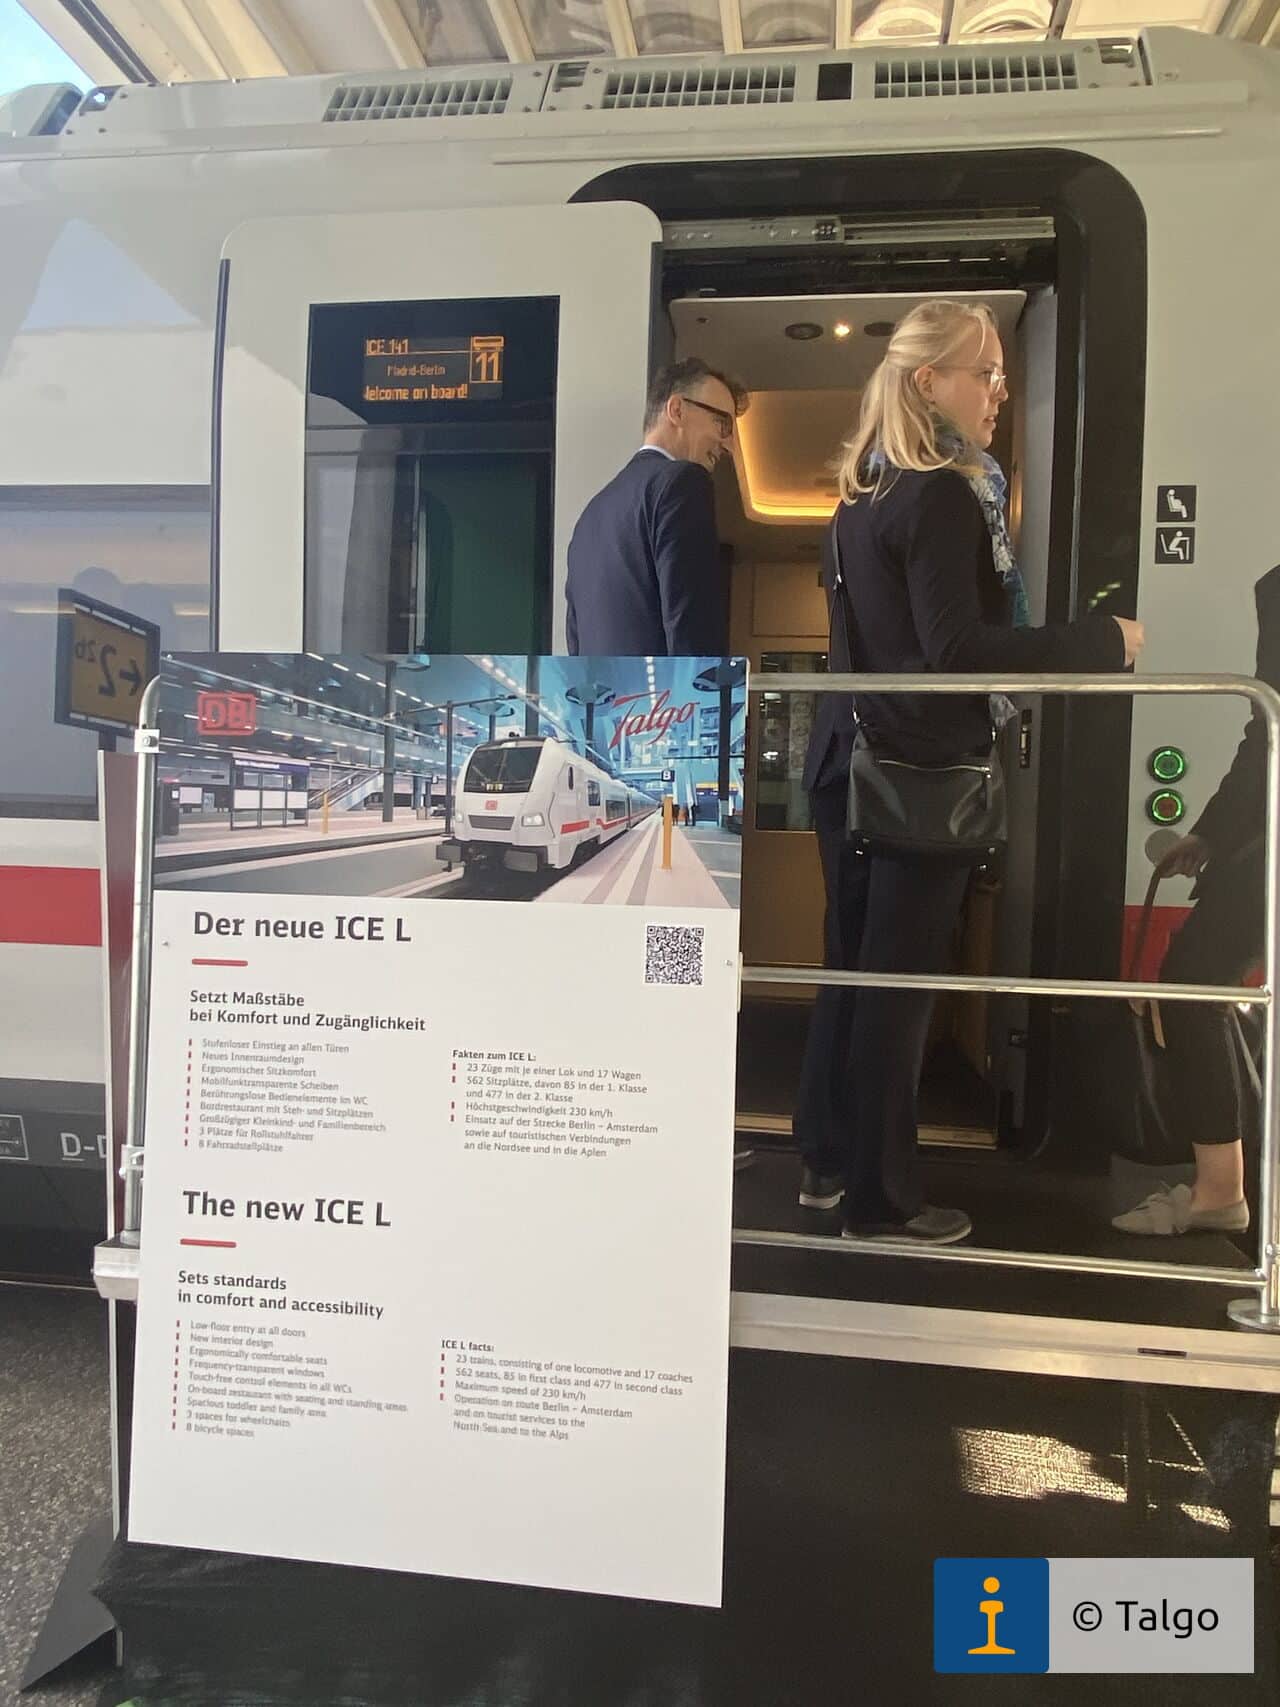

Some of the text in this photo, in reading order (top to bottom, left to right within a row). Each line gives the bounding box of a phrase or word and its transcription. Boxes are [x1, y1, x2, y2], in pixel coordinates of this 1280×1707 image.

[366, 338, 408, 354] ICE 141
[476, 351, 500, 381] 11
[413, 388, 428, 400] on
[431, 384, 468, 399] board!
[203, 697, 250, 731] DB
[608, 690, 700, 750] Talgo
[194, 911, 412, 942] Der neue ICE L
[190, 990, 304, 1007] Setzt Maßstäbe
[190, 1009, 426, 1032] bei Komfort und Zugänglichkeit
[453, 1050, 484, 1060] Fakten
[509, 1052, 525, 1060] ICE
[528, 1053, 536, 1062] L:
[467, 1063, 642, 1081] 23 Züge mit je einer Lok und 17 Wagen
[467, 1076, 484, 1086] 562
[535, 1080, 561, 1088] davon
[564, 1081, 576, 1090] 85
[578, 1082, 586, 1090] in
[590, 1082, 604, 1091] der
[619, 1084, 648, 1094] Klasse
[466, 1090, 483, 1098] und
[486, 1090, 502, 1099] 477
[506, 1091, 514, 1100] in
[517, 1092, 532, 1100] der
[546, 1093, 574, 1102] Klasse
[466, 1102, 613, 1119] Höchstgeschwindigkeit 230 km/h
[466, 1114, 658, 1134] Einsatz auf der Strecke Berlin Amsterdam
[465, 1129, 632, 1146] sowie auf touristischen Verbindungen
[464, 1142, 475, 1150] an
[478, 1142, 492, 1150] die
[494, 1142, 531, 1153] Nordsee
[534, 1146, 550, 1154] und
[564, 1146, 578, 1155] die
[183, 1190, 392, 1226] The new ICE L
[179, 1270, 287, 1290] Sets standards
[178, 1289, 384, 1320] in comfort and accessibility
[282, 1328, 306, 1337] doors
[246, 1338, 274, 1348] design
[442, 1340, 494, 1352] ICE L facts:
[456, 1354, 468, 1364] 23
[499, 1360, 542, 1372] consisting
[544, 1361, 553, 1370] of
[556, 1364, 572, 1372] one
[574, 1364, 622, 1377] locomotive
[624, 1369, 641, 1378] and
[644, 1370, 655, 1380] 17
[658, 1372, 694, 1384] coaches
[456, 1368, 472, 1377] 562
[504, 1372, 515, 1381] 85
[518, 1372, 526, 1381] in
[529, 1373, 547, 1384] first
[550, 1376, 571, 1386] class
[574, 1378, 590, 1388] and
[594, 1380, 611, 1390] 477
[614, 1382, 622, 1390] in
[626, 1383, 658, 1394] second
[660, 1386, 683, 1396] class
[456, 1380, 586, 1401] Maximum speed of 230 km/h
[516, 1401, 540, 1410] route
[542, 1402, 570, 1412] Berlin
[581, 1405, 632, 1418] Amsterdam
